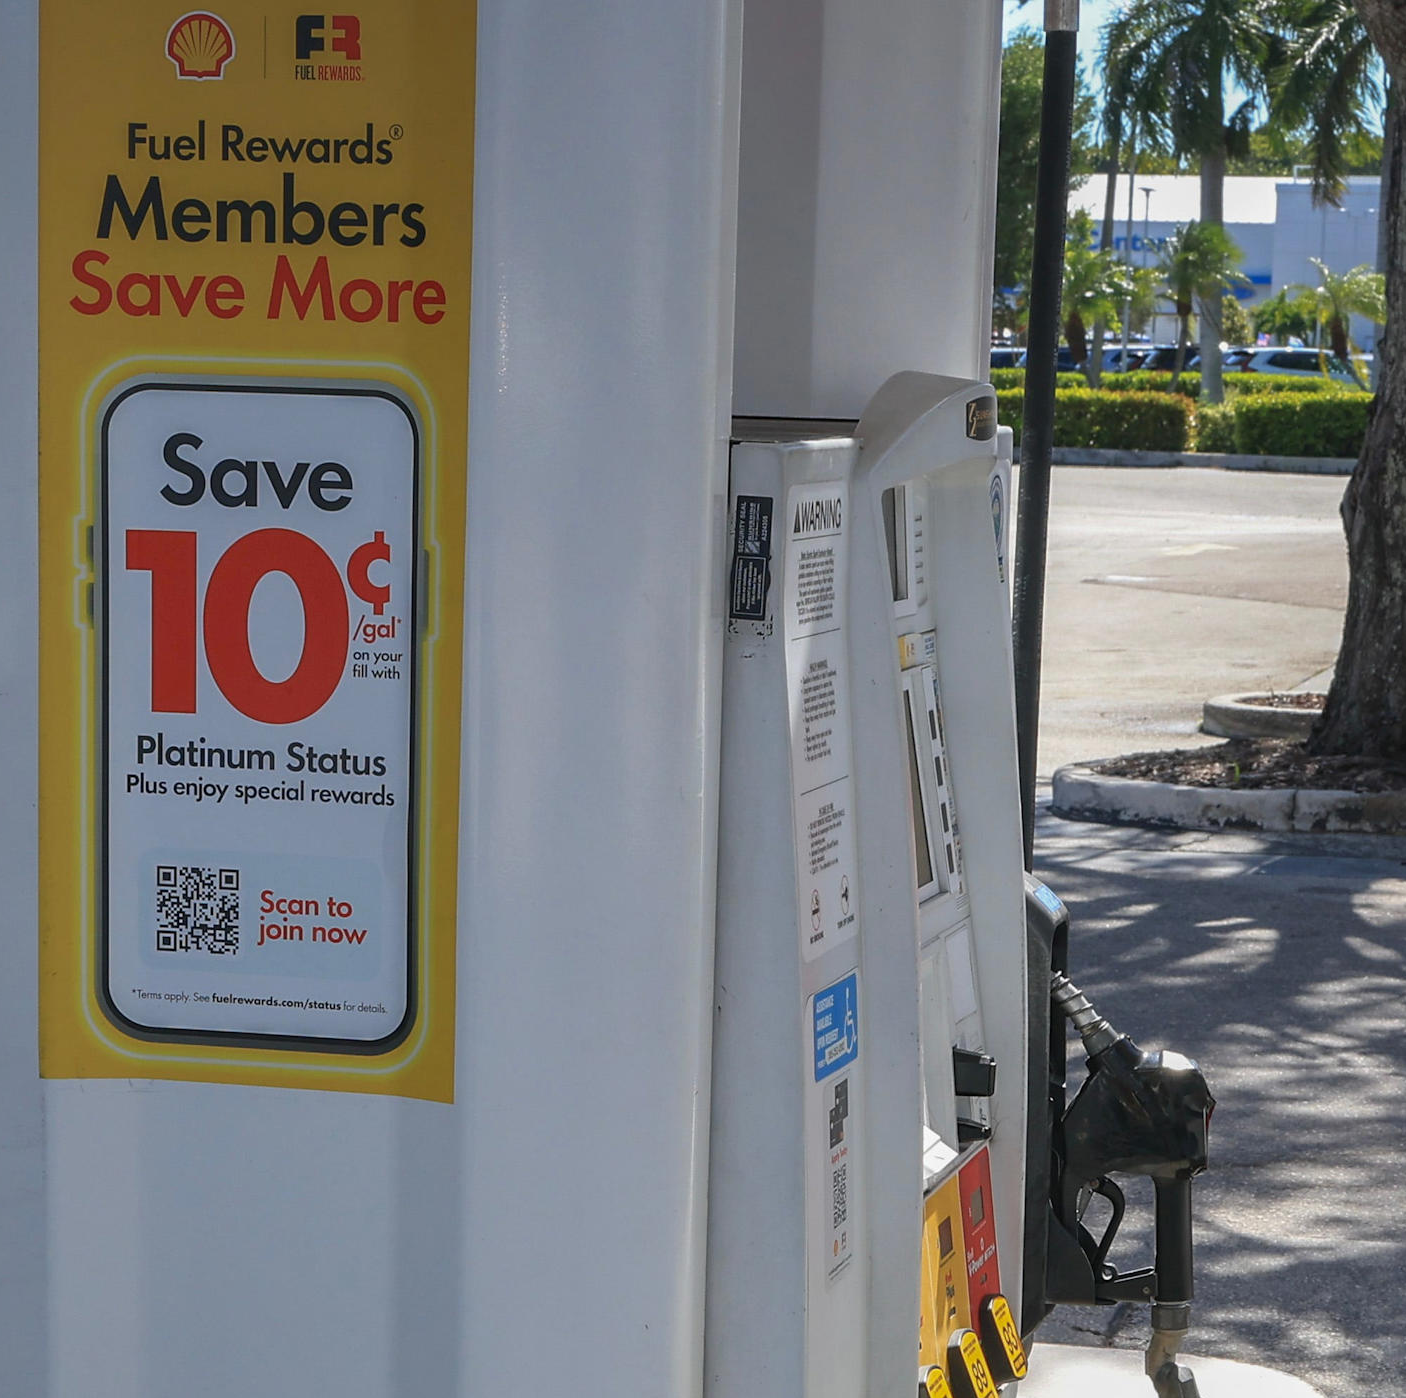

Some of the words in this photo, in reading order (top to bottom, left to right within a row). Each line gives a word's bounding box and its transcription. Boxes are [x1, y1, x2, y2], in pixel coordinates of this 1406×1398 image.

[295, 65, 316, 81] FUEL
[128, 120, 206, 161] Fuel
[96, 173, 426, 248] Members
[69, 249, 245, 319] Save
[267, 254, 447, 326] More
[160, 432, 354, 511] Save
[801, 498, 842, 533] WARNING
[352, 664, 369, 680] fill
[371, 665, 400, 680] with
[353, 652, 371, 661] on
[373, 652, 403, 665] your
[136, 734, 276, 772] Platinum
[286, 741, 387, 776] Status
[126, 773, 167, 796] Plus
[173, 778, 228, 803] enjoy
[234, 780, 305, 804] special
[311, 784, 396, 807] rewards
[259, 890, 318, 917] Scan
[326, 896, 352, 918] to
[257, 917, 304, 946] join
[312, 925, 368, 945] now
[164, 991, 191, 1004] apply.
[193, 991, 210, 1003] See
[212, 991, 342, 1011] fuelrewards.com/status
[343, 1000, 355, 1012] for
[357, 1001, 388, 1014] details.
[1003, 1322, 1018, 1354] 93
[972, 1359, 988, 1393] 89
